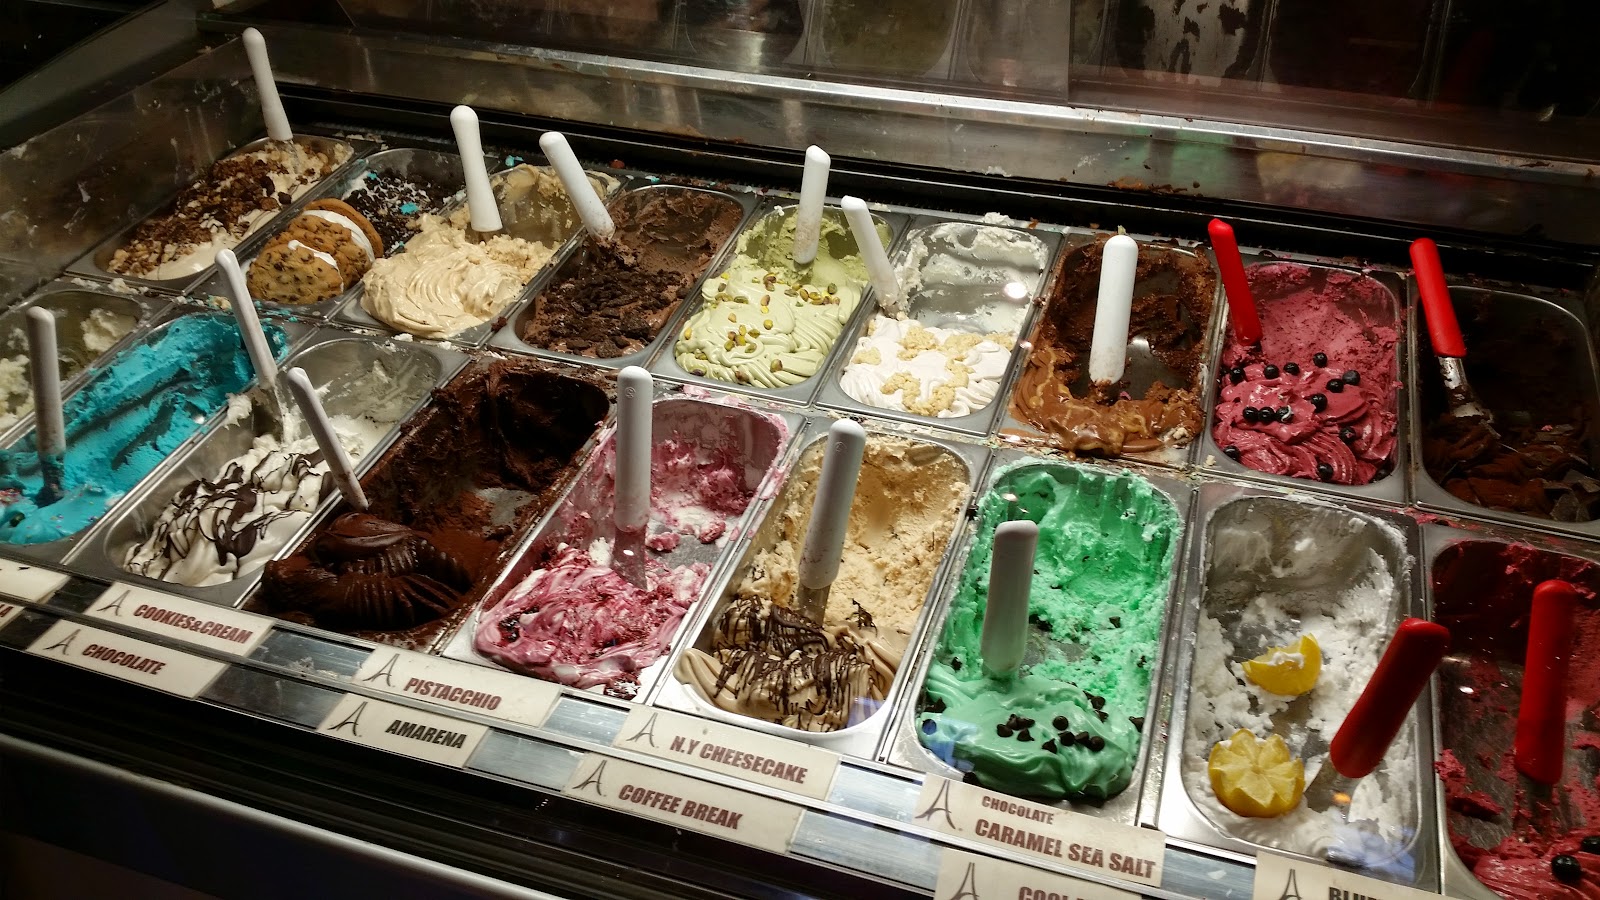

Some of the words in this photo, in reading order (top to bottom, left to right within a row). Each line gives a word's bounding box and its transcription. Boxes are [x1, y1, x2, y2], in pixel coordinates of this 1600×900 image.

[134, 604, 253, 644] COOKIES&CREAM
[83, 643, 166, 675] CHOCOLATE
[404, 677, 502, 711] PISTACCHIO
[385, 720, 467, 748] AMARENA
[670, 735, 700, 755] N.Y
[699, 743, 808, 784] CHEESECAKE
[618, 784, 681, 813] COFFEE
[681, 801, 743, 830] BREAK
[981, 795, 1054, 824] CHOCOLATE
[975, 818, 1064, 858] CARAMEL
[1068, 843, 1104, 868] SEA
[1109, 852, 1156, 878] SALT
